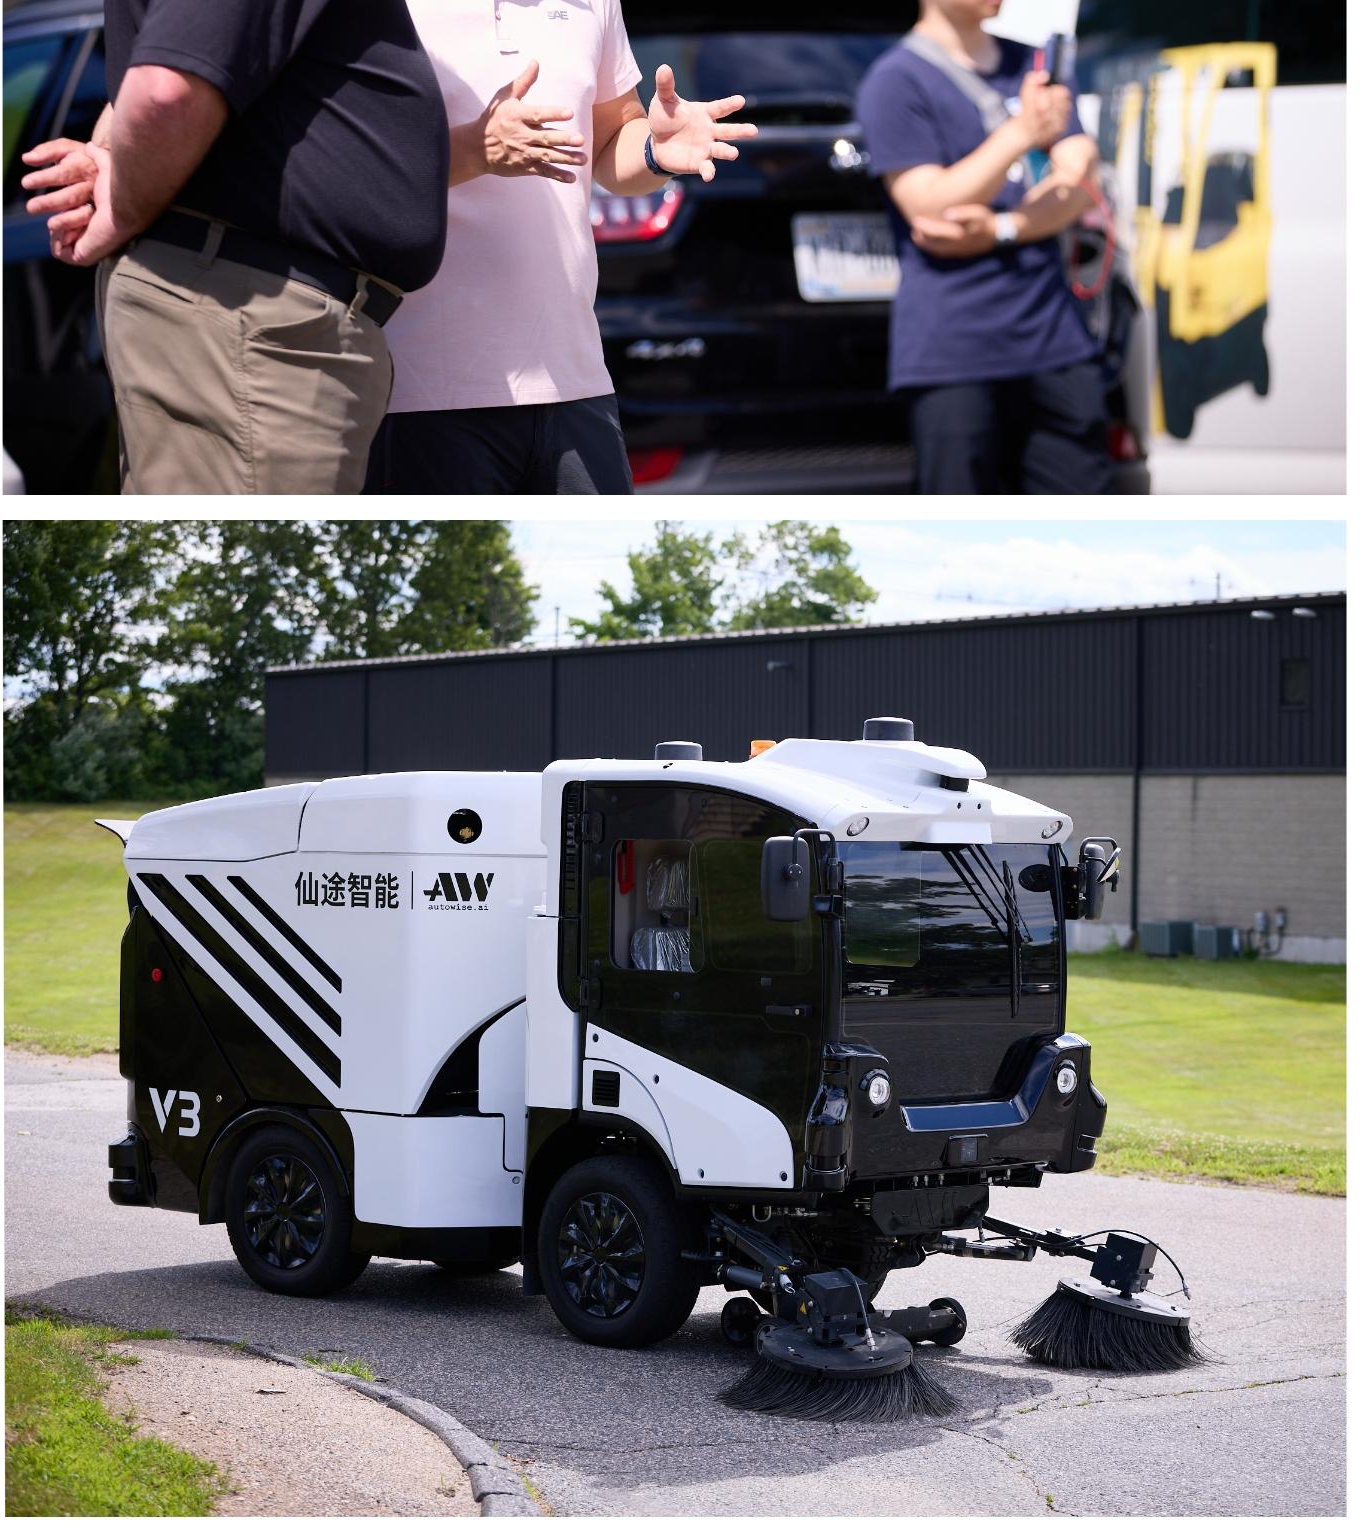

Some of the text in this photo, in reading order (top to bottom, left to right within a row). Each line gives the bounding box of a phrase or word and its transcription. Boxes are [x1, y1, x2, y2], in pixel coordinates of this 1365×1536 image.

[295, 871, 495, 909] 仙途智能 AW
[427, 903, 489, 911] autowise.ai
[148, 1087, 201, 1137] V3
